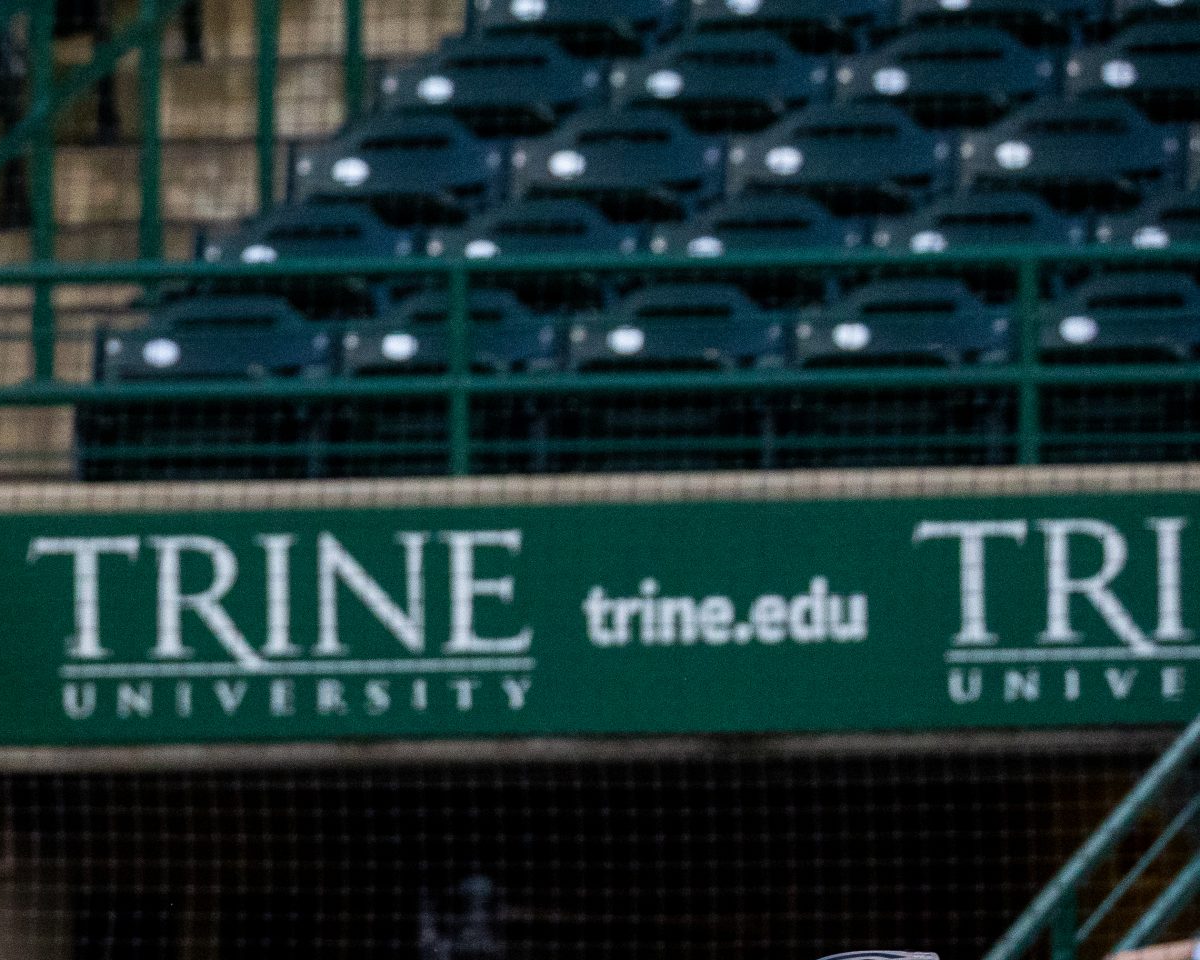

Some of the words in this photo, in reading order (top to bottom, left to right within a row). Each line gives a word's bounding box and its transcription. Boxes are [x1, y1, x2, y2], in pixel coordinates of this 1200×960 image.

[26, 529, 534, 672] TRINE
[583, 576, 868, 646] trine.edu
[911, 516, 1189, 656] TRI
[61, 675, 533, 720] UNIVERSITY
[947, 667, 1186, 703] UNIVE
